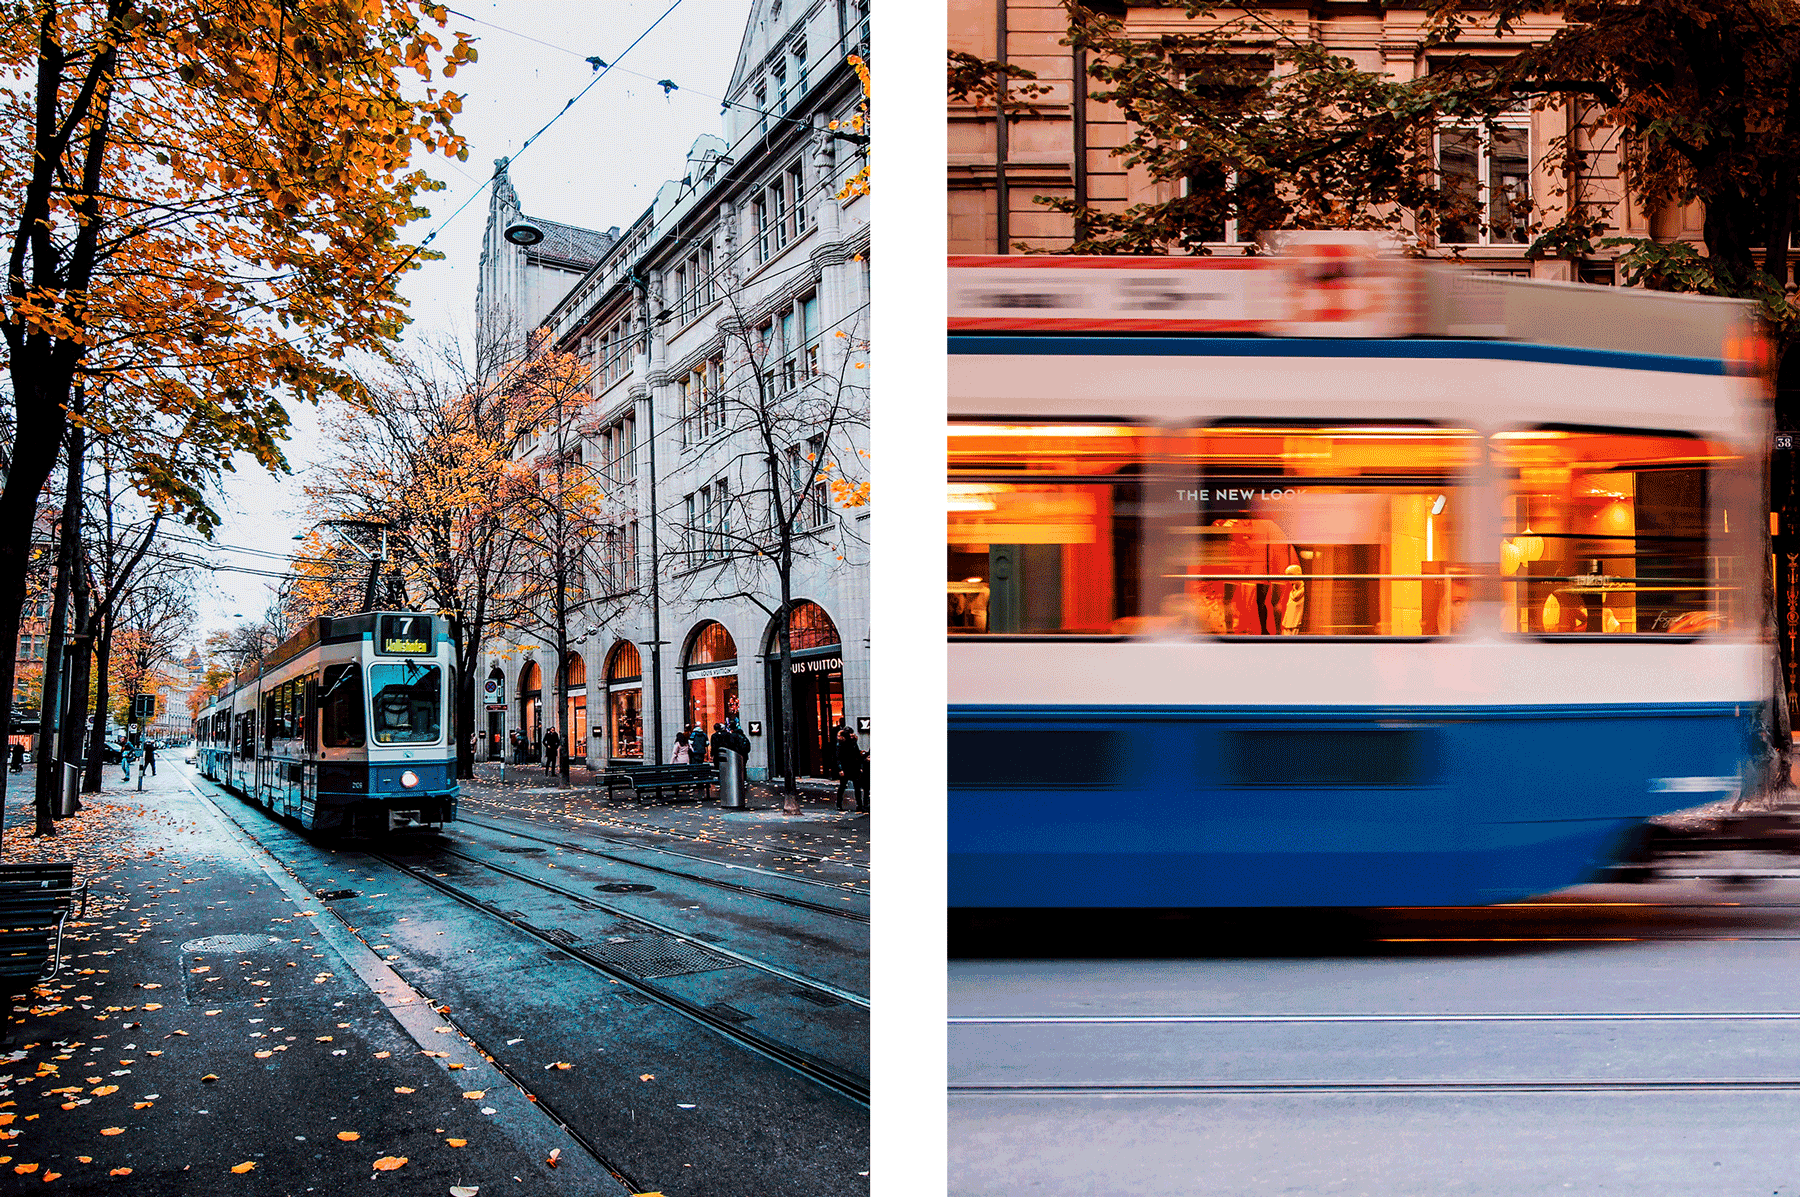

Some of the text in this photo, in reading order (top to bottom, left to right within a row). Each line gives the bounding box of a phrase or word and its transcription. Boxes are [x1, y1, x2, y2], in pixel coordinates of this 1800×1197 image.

[1777, 438, 1791, 448] 38
[1176, 489, 1210, 501] THE
[1216, 489, 1255, 501] NEW
[400, 617, 413, 635] 7
[791, 658, 845, 674] UIS VUITTON
